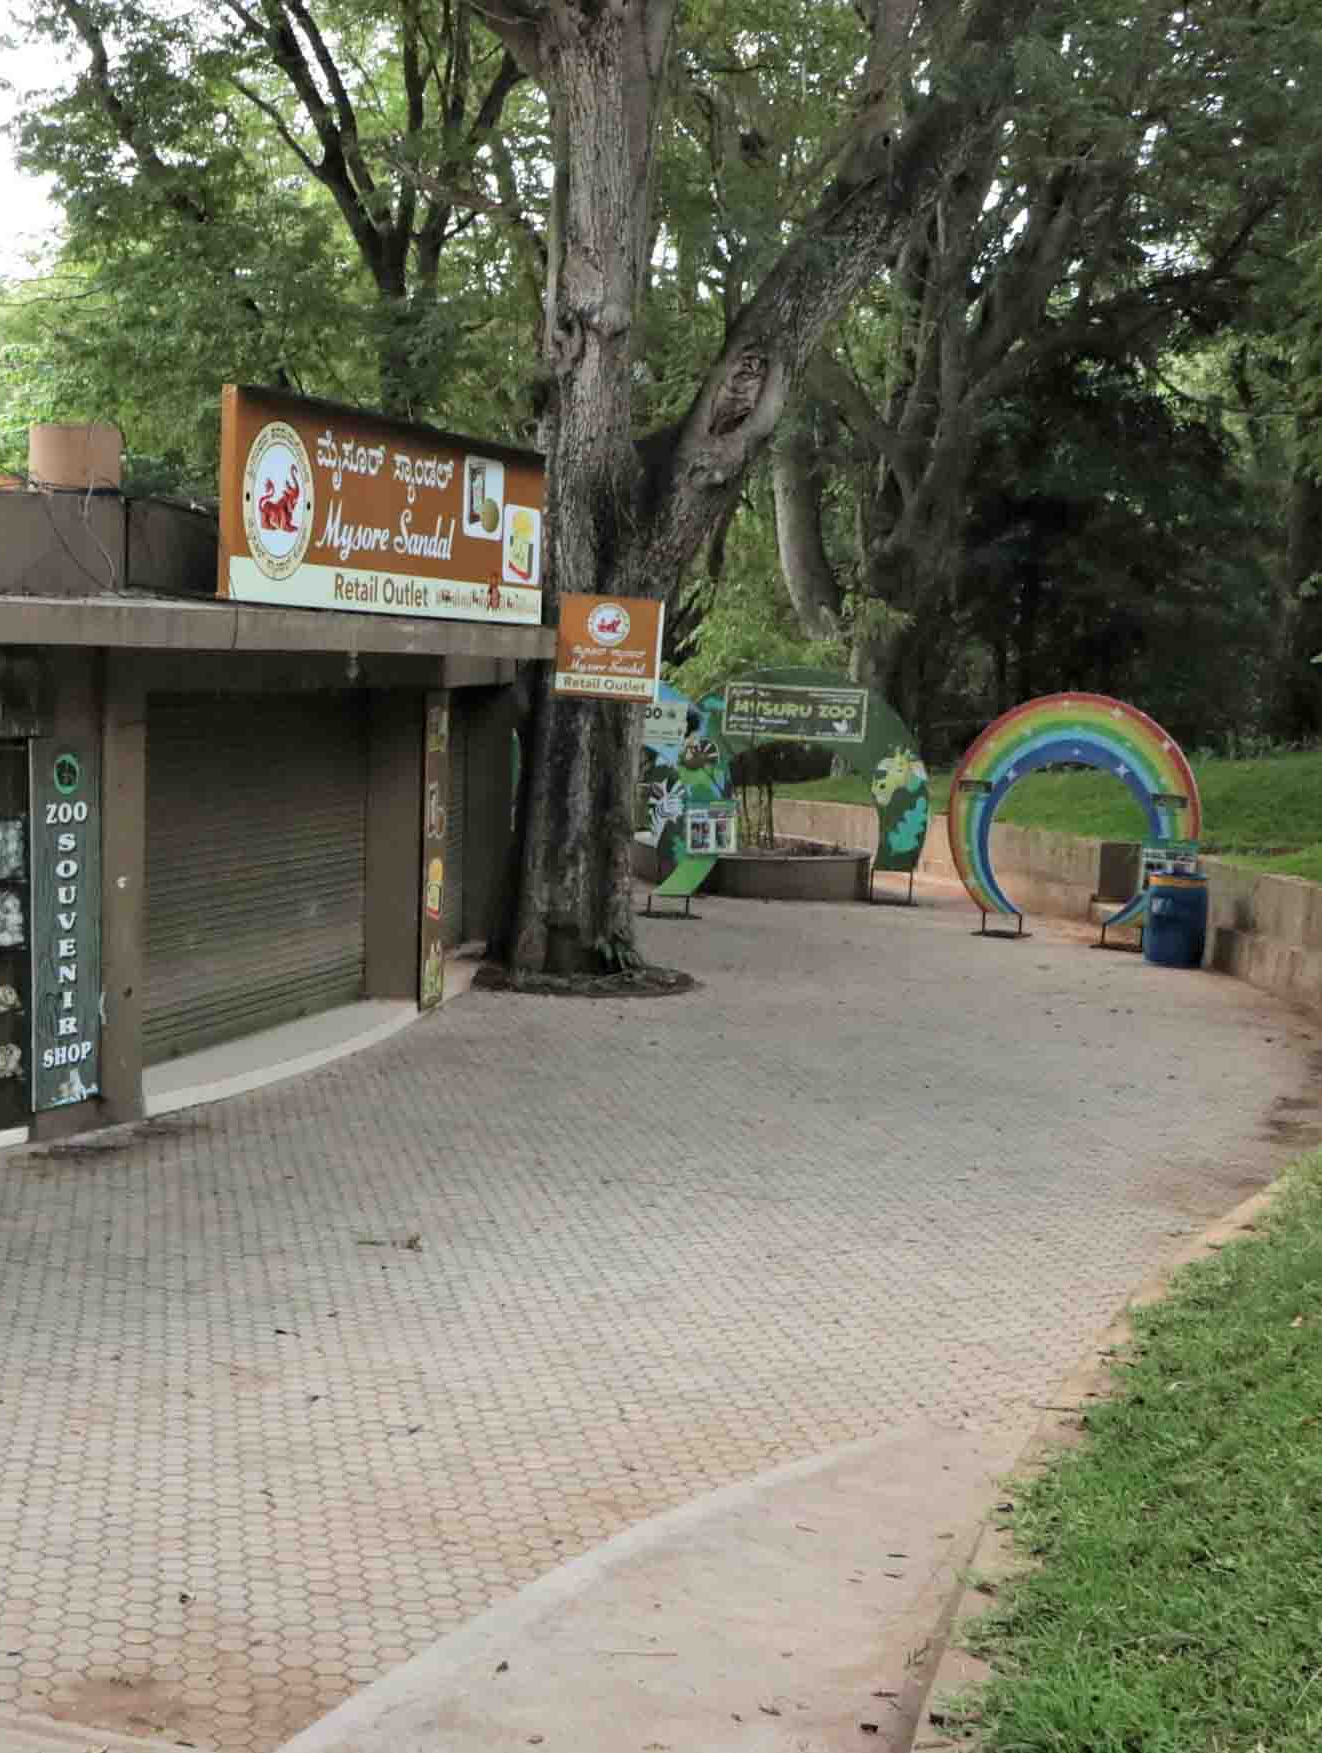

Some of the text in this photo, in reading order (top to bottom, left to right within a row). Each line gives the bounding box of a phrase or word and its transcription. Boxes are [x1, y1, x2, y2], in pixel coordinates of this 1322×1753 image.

[315, 499, 456, 561] Mysore Sandal
[334, 573, 378, 603] Retail
[382, 578, 428, 608] Outlet
[566, 675, 646, 693] Retail Outlet
[819, 704, 857, 719] ZOO
[46, 801, 87, 824] ZOO
[55, 833, 78, 1035] SOUVENIR
[43, 1041, 92, 1068] SHOP
